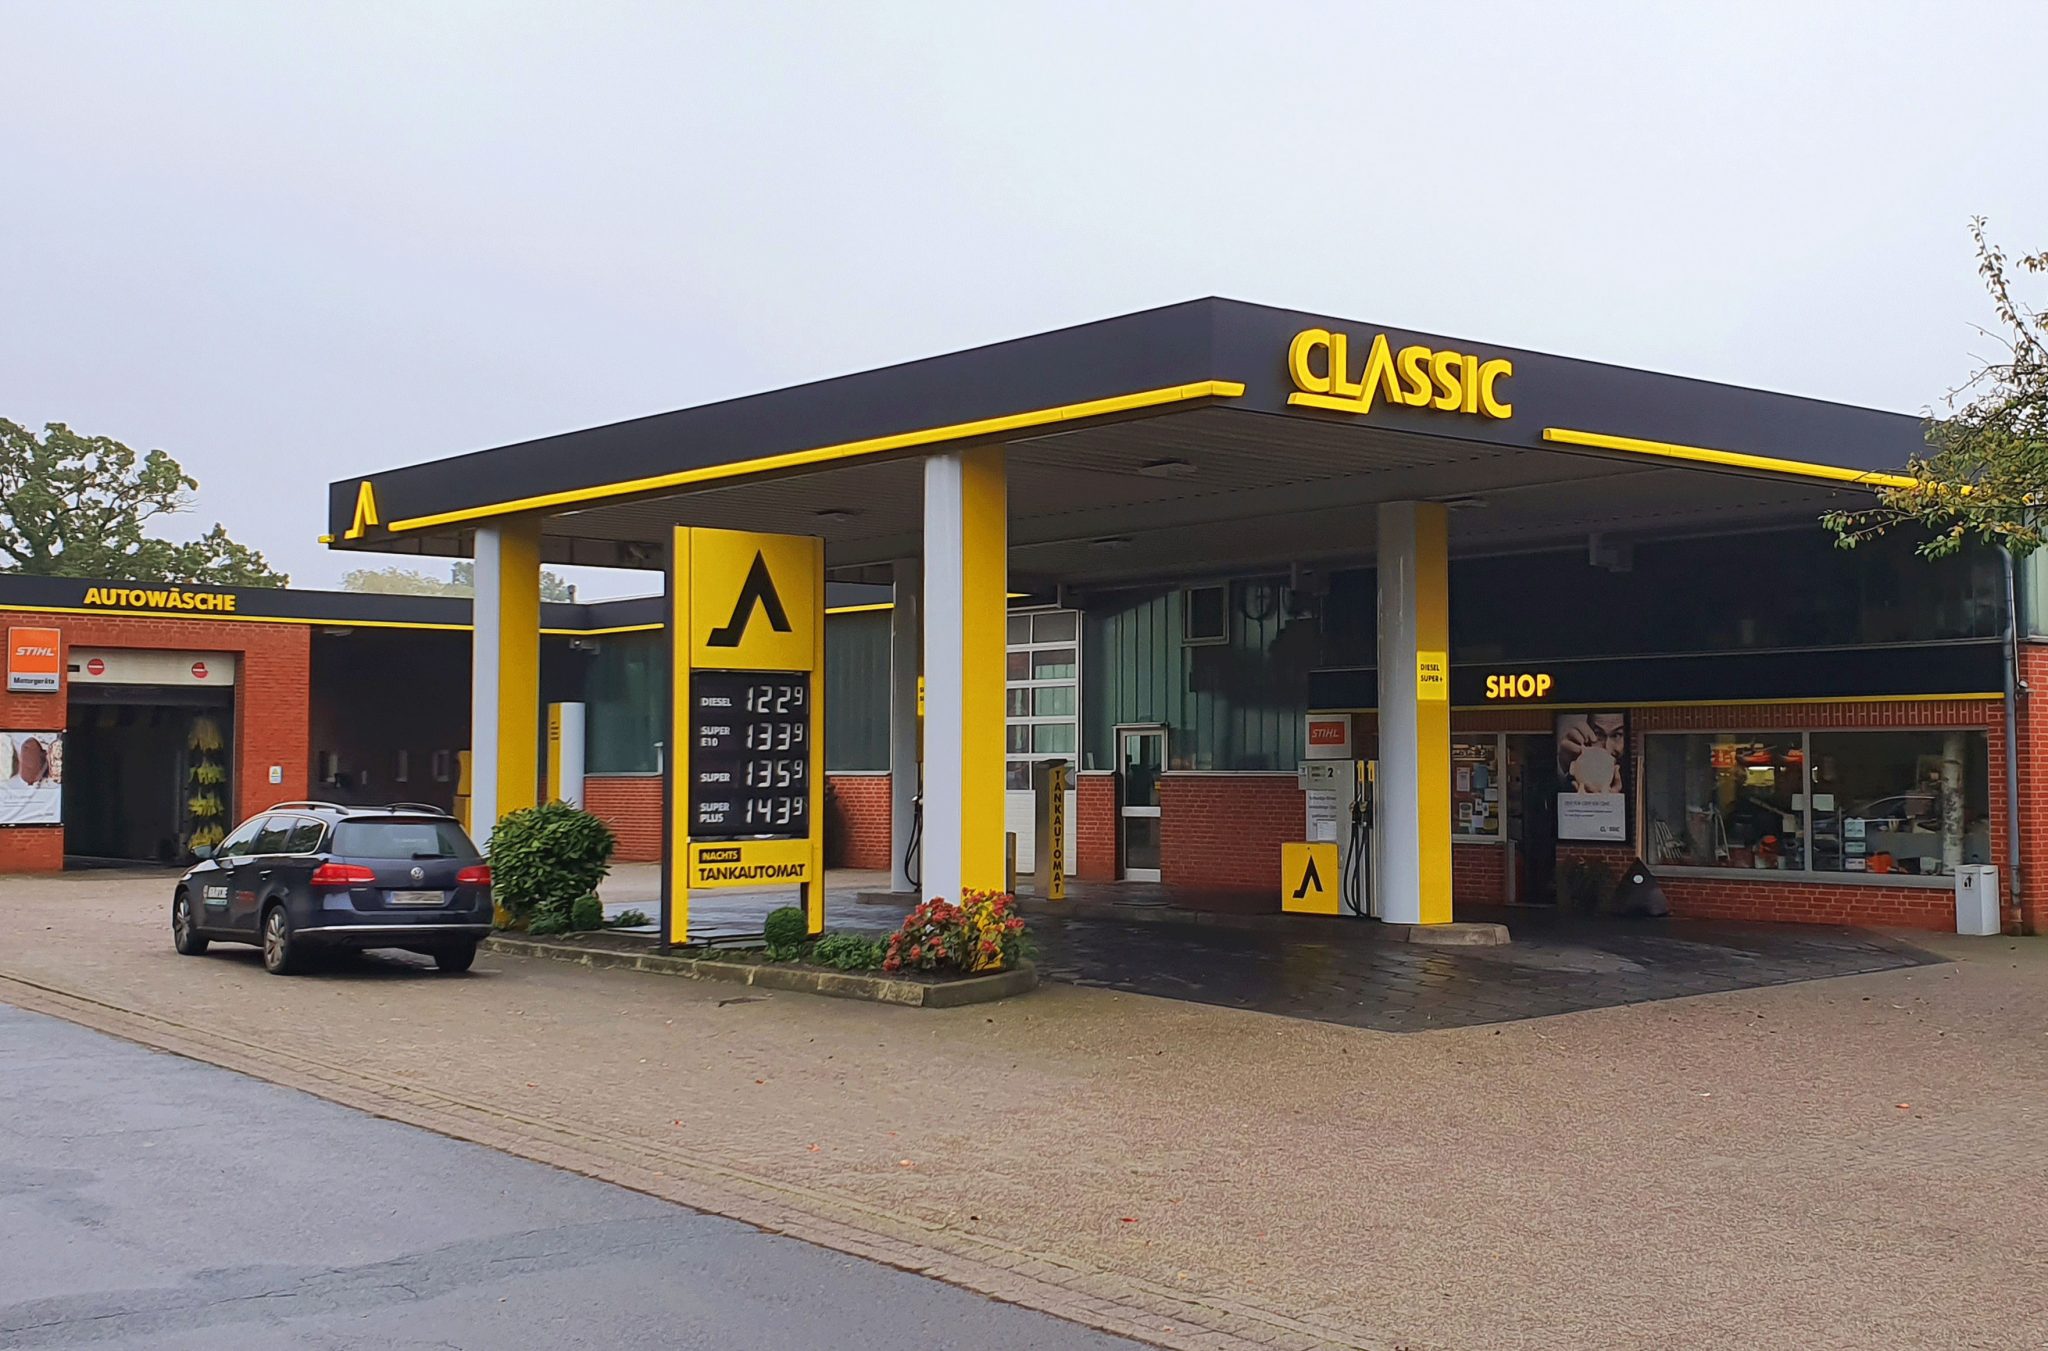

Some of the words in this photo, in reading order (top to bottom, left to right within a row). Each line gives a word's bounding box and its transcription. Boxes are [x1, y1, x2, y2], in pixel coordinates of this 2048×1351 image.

[1287, 328, 1512, 419] CLASSIC
[84, 587, 236, 611] AUTOWÄSCHE
[15, 646, 55, 657] STIHL
[1420, 663, 1440, 671] DIESEL
[1486, 674, 1551, 698] SHOP
[701, 697, 732, 707] DIESEL
[701, 726, 731, 736] SUPER
[1311, 727, 1340, 738] STIHL
[701, 737, 719, 747] E10
[700, 773, 731, 783] SUPER
[1327, 767, 1334, 778] 2
[700, 802, 730, 812] SUPER
[700, 813, 724, 823] PLUS
[1053, 770, 1062, 893] TANKAUTOMAT
[702, 850, 738, 862] NACHTS
[699, 864, 805, 881] TANKAUTOMAT
